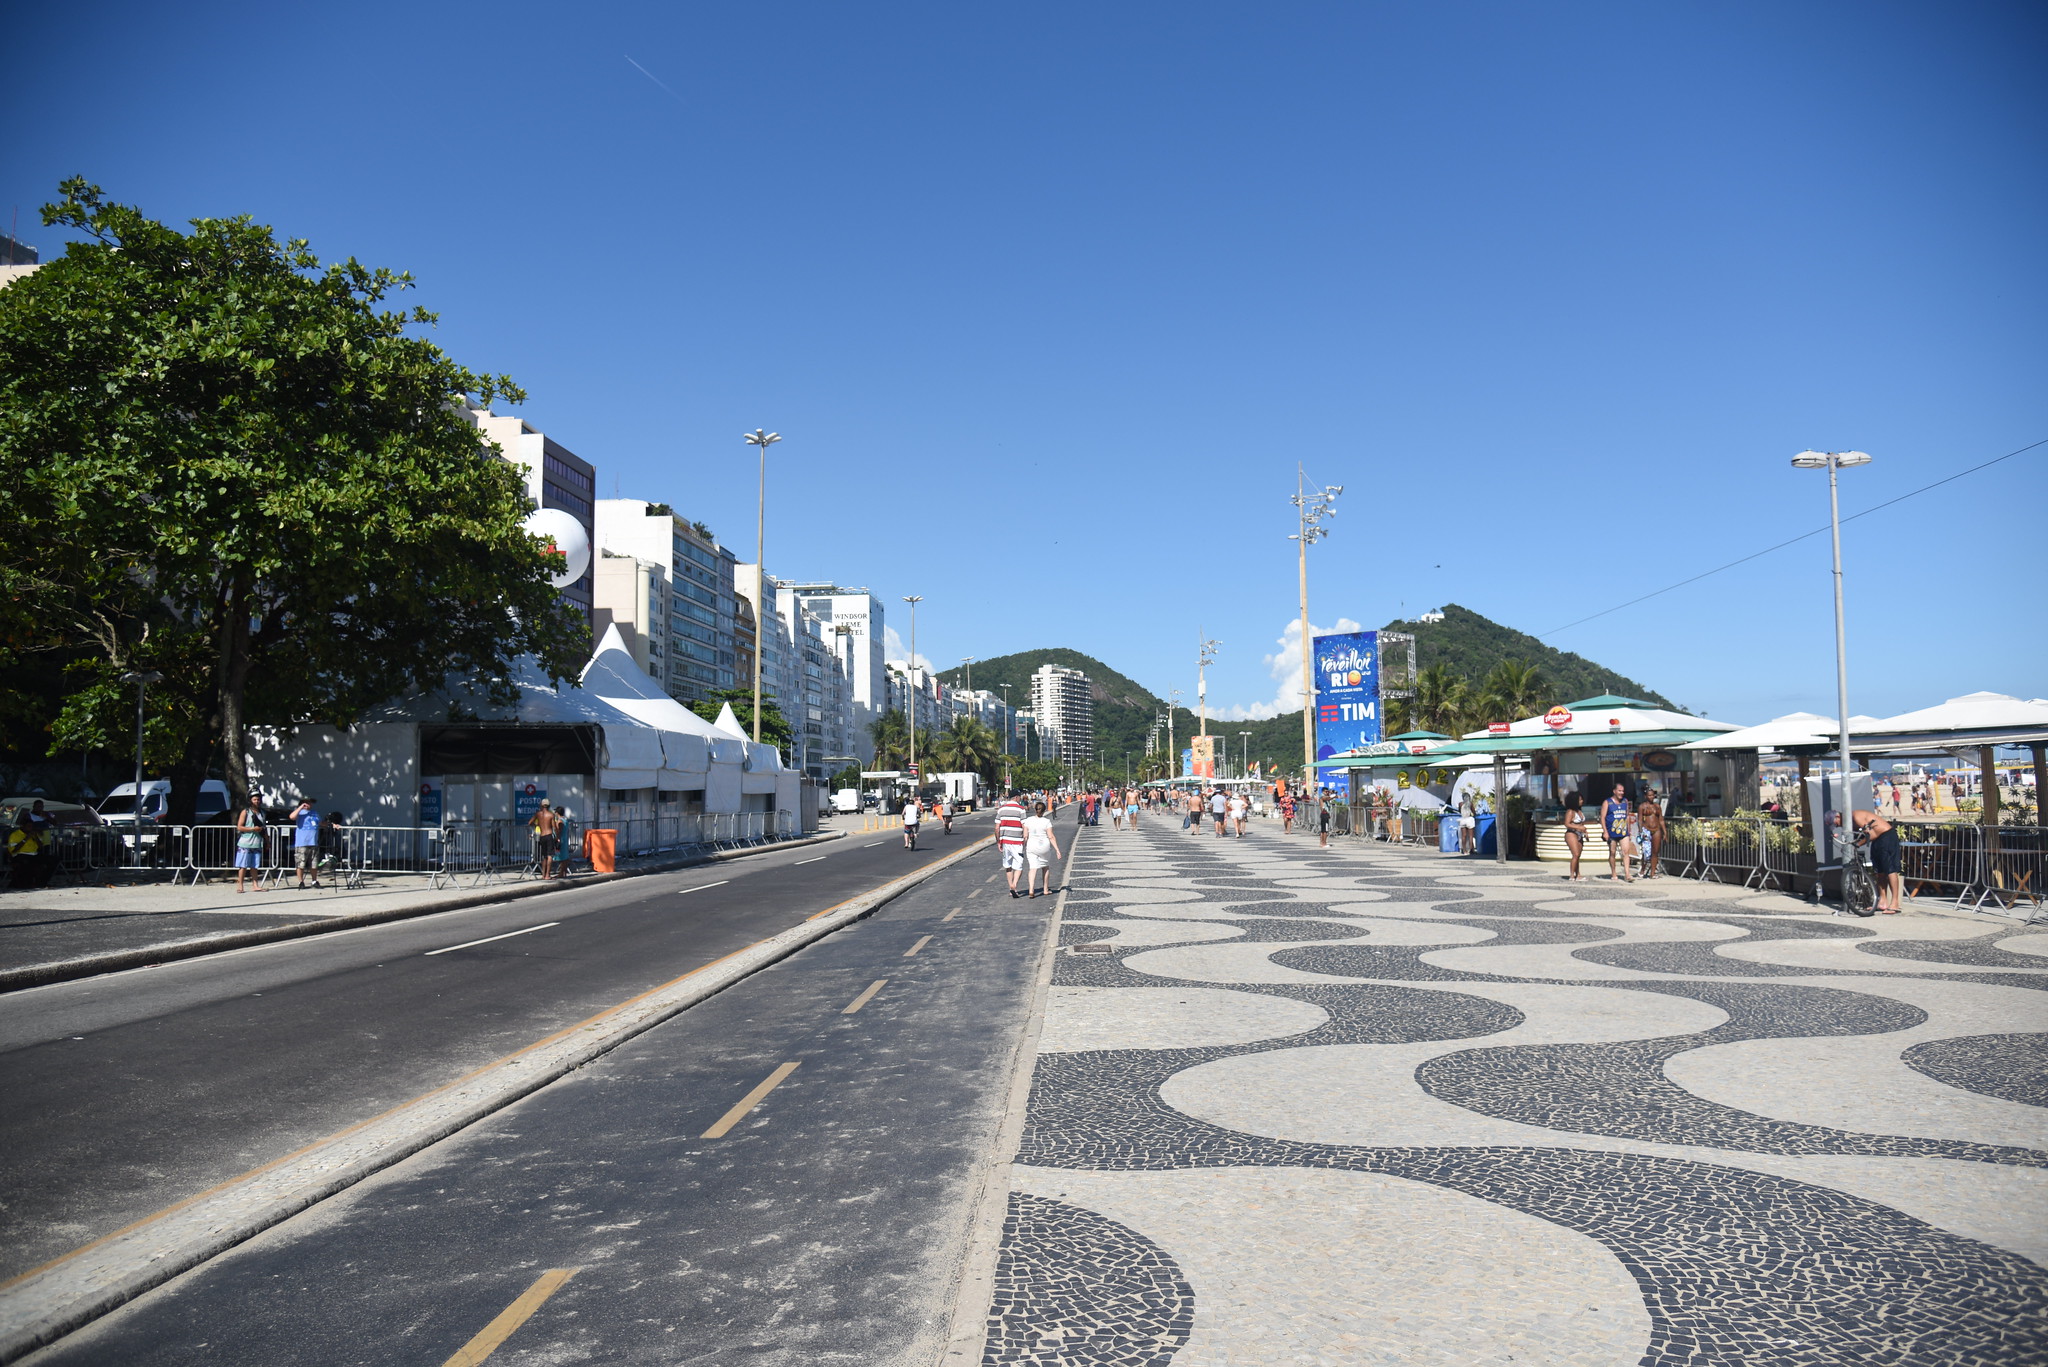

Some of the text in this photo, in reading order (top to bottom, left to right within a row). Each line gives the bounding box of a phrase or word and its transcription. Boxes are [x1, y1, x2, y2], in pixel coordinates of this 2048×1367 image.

[1331, 670, 1362, 687] RIO
[1340, 702, 1375, 721] TIM
[1397, 741, 1409, 753] A
[1396, 768, 1449, 789] 202
[420, 796, 437, 804] OSTO
[519, 797, 541, 805] POSTO
[422, 806, 439, 814] DICO
[517, 805, 541, 814] MÉDIC
